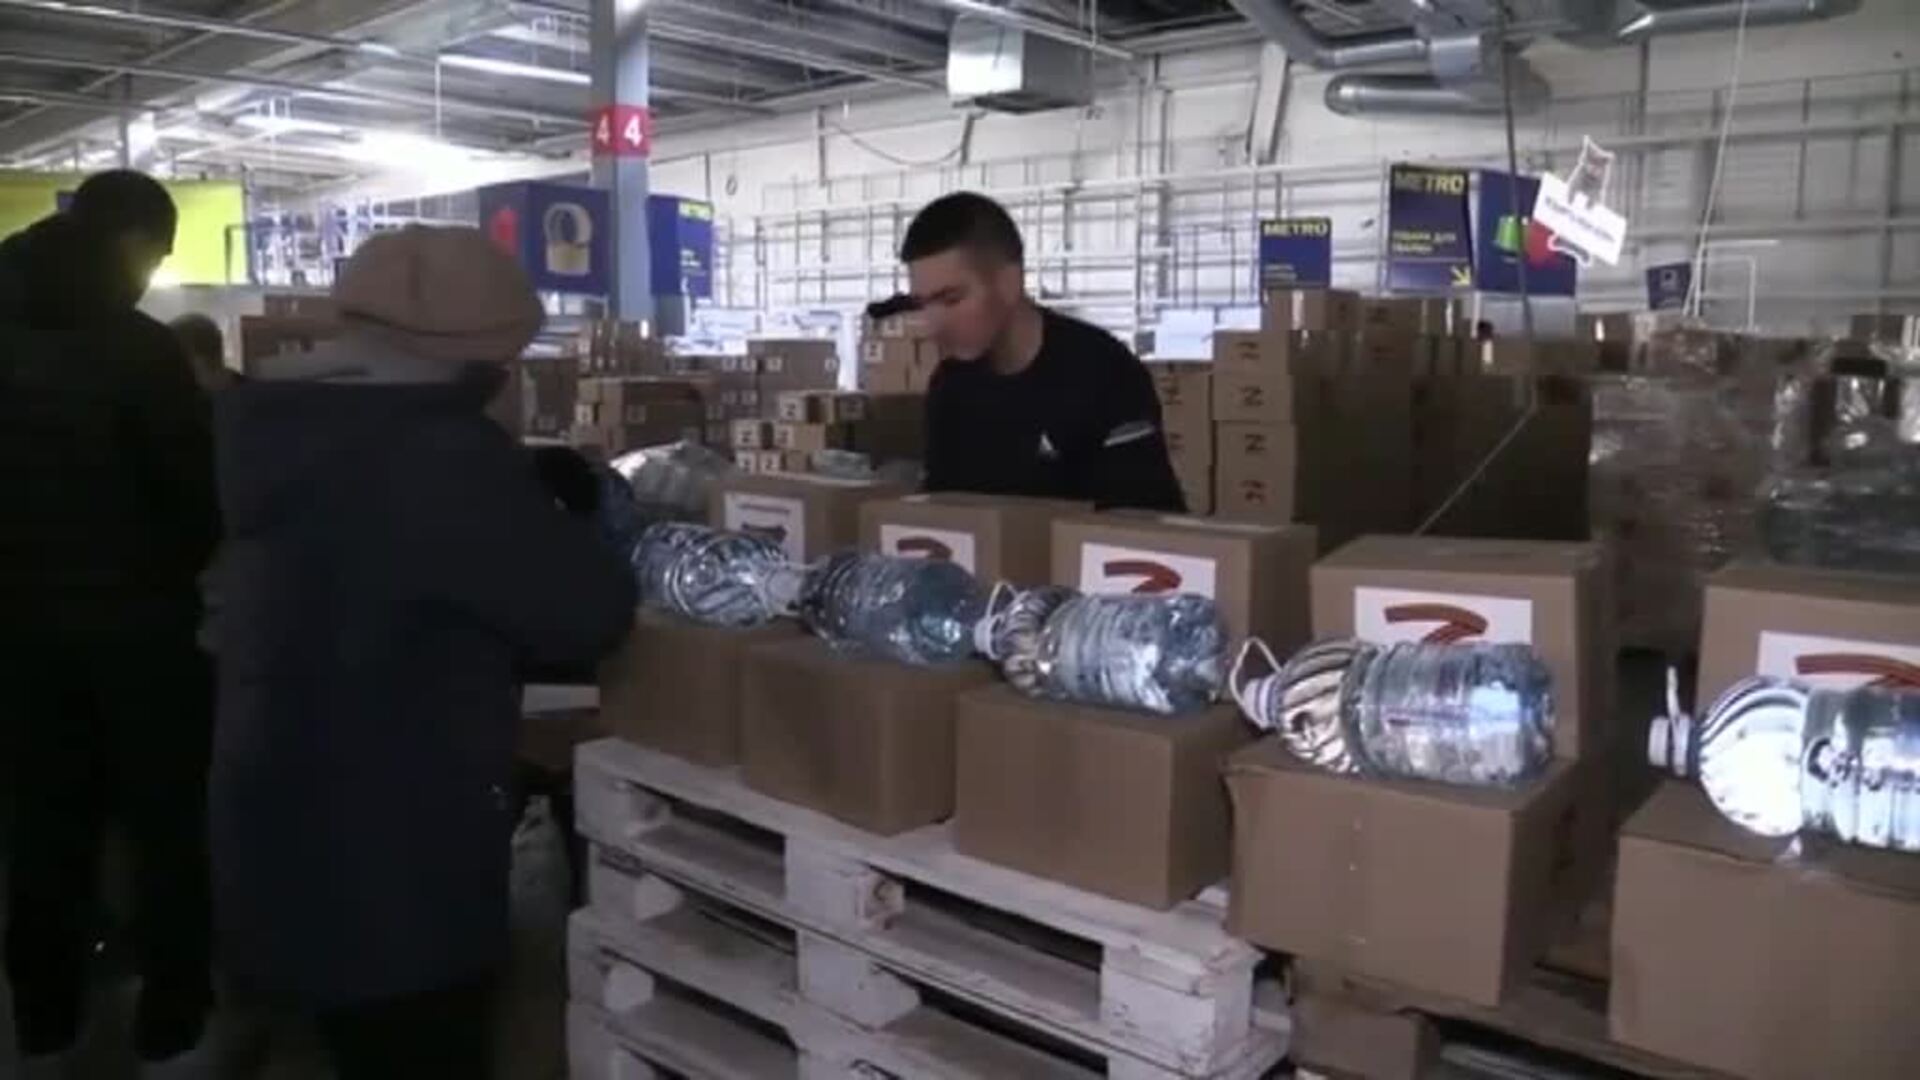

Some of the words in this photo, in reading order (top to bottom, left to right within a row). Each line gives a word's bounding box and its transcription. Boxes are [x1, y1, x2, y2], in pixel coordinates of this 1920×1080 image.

[595, 111, 611, 146] 4
[623, 114, 644, 147] 4
[1394, 171, 1466, 195] METRO
[1263, 223, 1329, 237] METRO
